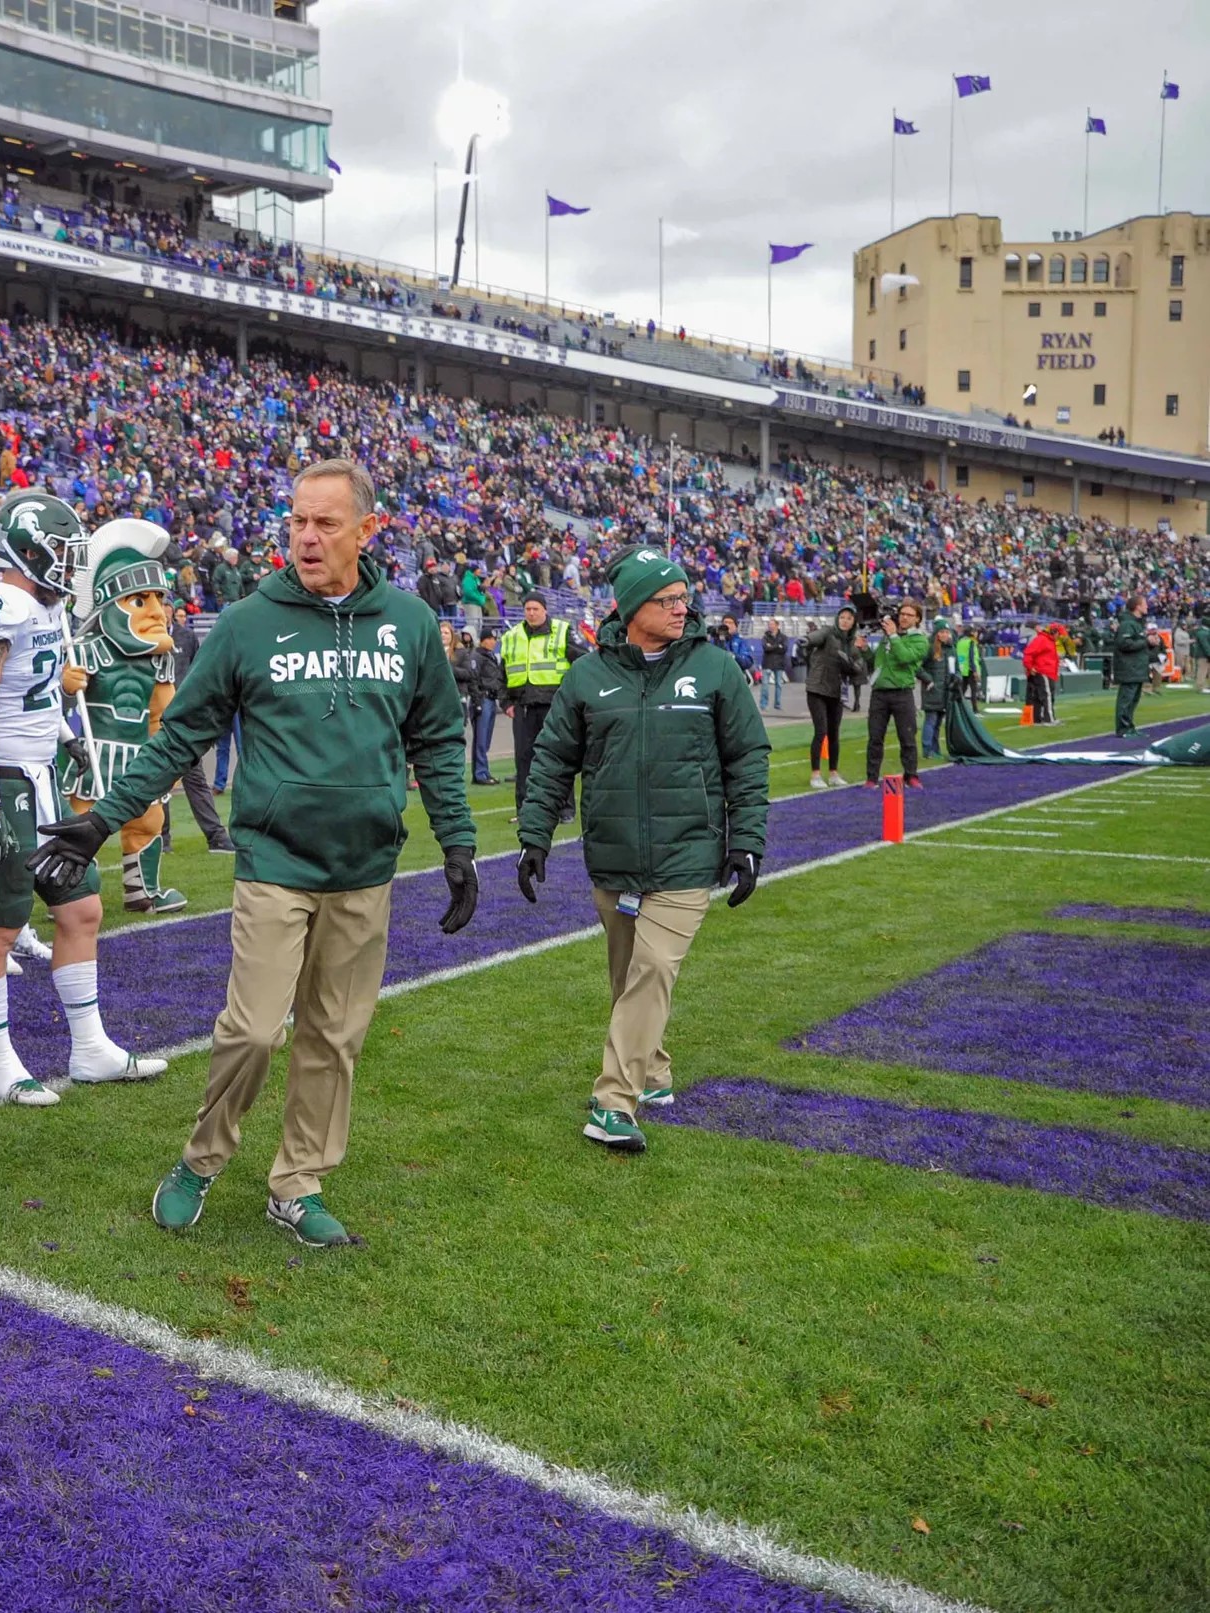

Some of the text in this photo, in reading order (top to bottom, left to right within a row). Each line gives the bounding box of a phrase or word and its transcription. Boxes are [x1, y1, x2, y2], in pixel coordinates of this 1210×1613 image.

[1040, 332, 1093, 349] RYAN
[1036, 353, 1097, 370] FIELD
[815, 398, 838, 416] 1926
[846, 402, 869, 422] 1930
[877, 408, 898, 427] 1931
[937, 420, 960, 439] 1995
[999, 431, 1027, 450] 2000
[269, 650, 406, 683] SPARTANS
